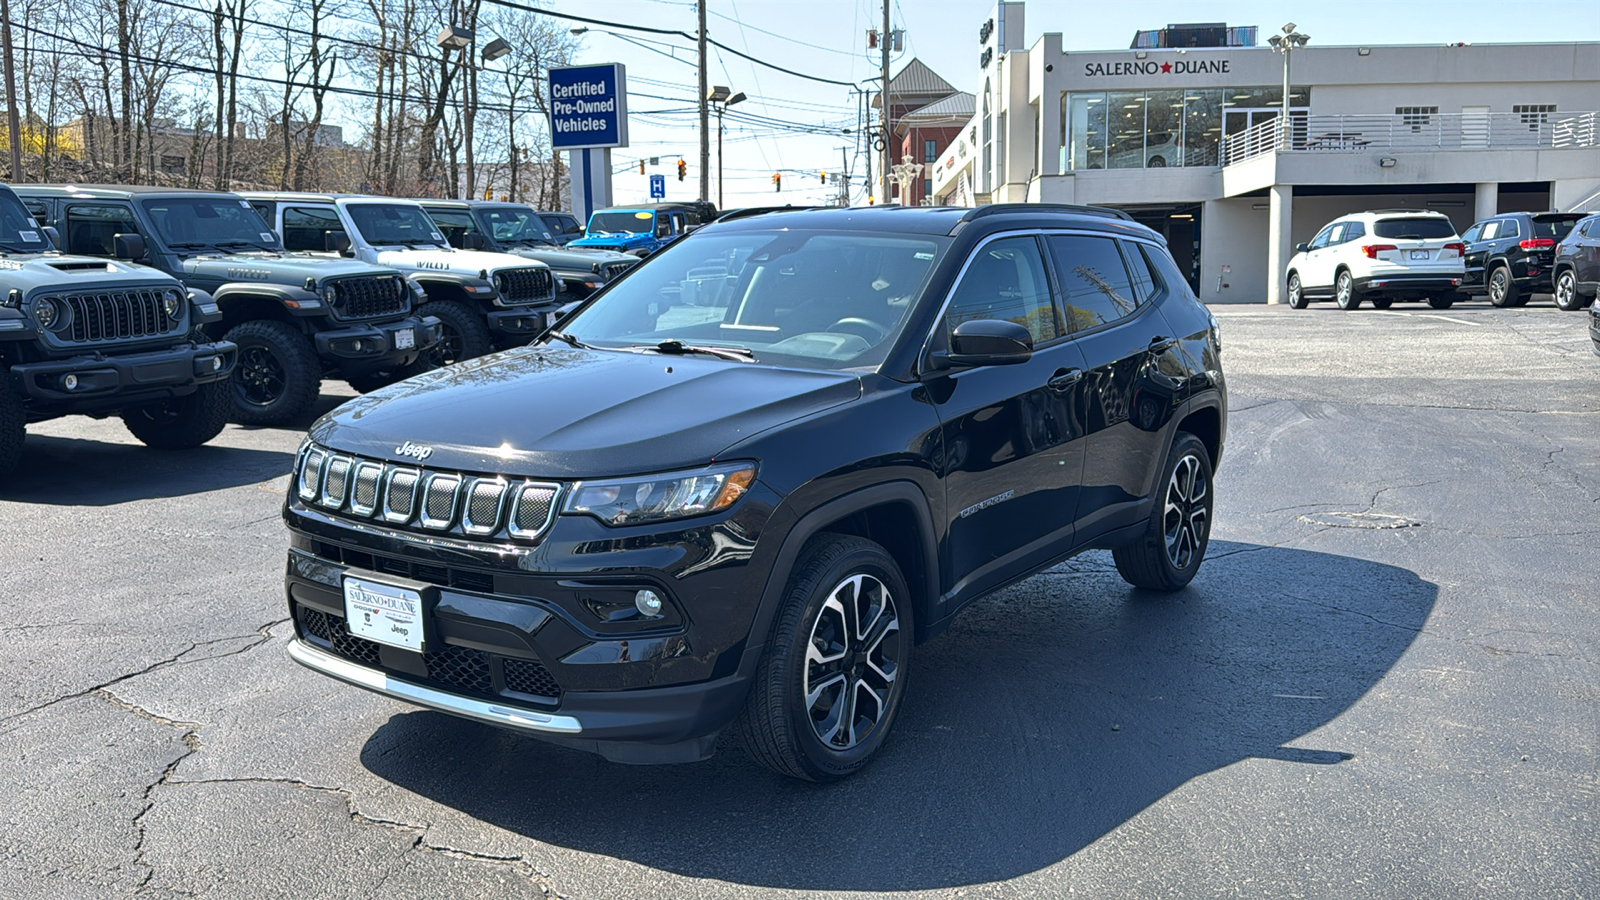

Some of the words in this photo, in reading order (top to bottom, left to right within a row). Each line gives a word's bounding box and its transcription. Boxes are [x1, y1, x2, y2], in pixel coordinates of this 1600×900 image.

[1085, 61, 1159, 77] SALERNO
[1174, 60, 1230, 74] DUANE
[552, 80, 606, 98] Certified
[553, 98, 614, 115] Pre-Owned
[554, 117, 607, 133] Vehicles
[653, 180, 662, 191] H
[395, 440, 433, 461] Jeep
[349, 589, 384, 606] SALERNO
[387, 598, 417, 614] DUANE
[391, 624, 409, 637] Jeep
